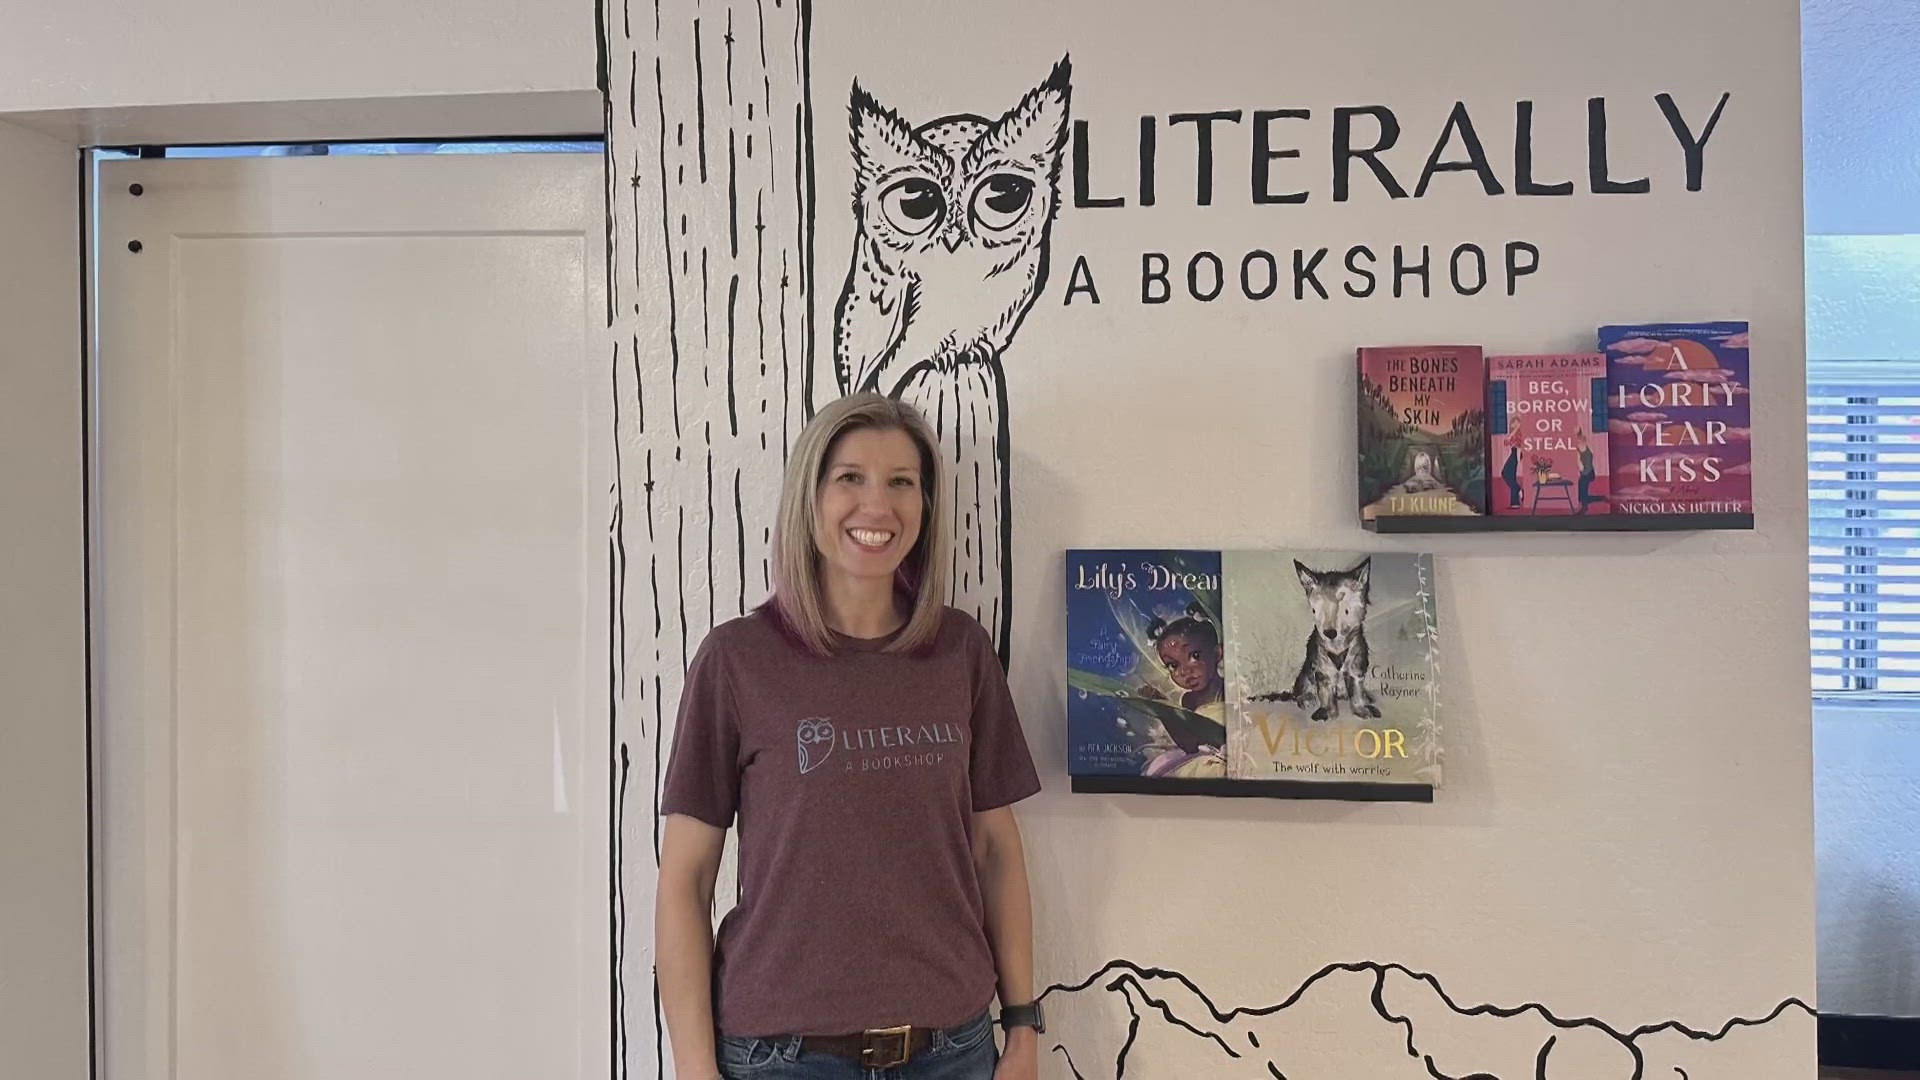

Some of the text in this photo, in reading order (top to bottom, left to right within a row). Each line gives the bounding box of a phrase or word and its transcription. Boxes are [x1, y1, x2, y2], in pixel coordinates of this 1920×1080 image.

[1073, 92, 1730, 208] LITERALLY
[1063, 240, 1540, 305] A BOOKSHOP
[1387, 357, 1458, 374] THE BONES
[1497, 357, 1600, 370] SARAH ADAMS
[1667, 346, 1689, 370] A
[1389, 375, 1455, 392] BENEATH
[1528, 381, 1569, 396] BEG,
[1414, 394, 1431, 406] MY
[1618, 382, 1741, 409] FORTY
[1506, 398, 1593, 415] BORROW,
[1403, 408, 1440, 425] SKIN
[1535, 419, 1563, 432] OR
[1631, 420, 1727, 446] YEAR
[1523, 437, 1577, 451] STEAL
[1639, 457, 1721, 482] KISS
[1389, 496, 1457, 512] TJ KLUNE
[1620, 501, 1742, 514] NICKOLAS BUTLER
[1074, 562, 1137, 600] Lily's
[1371, 665, 1425, 682] Catherine
[1380, 683, 1421, 700] Rayner
[842, 722, 964, 751] LITERALLY
[1253, 712, 1409, 760] VICTOR
[1103, 743, 1132, 754] JACKSON
[845, 752, 944, 772] A BOOKSHOP
[1272, 761, 1391, 776] The wolf with worries
